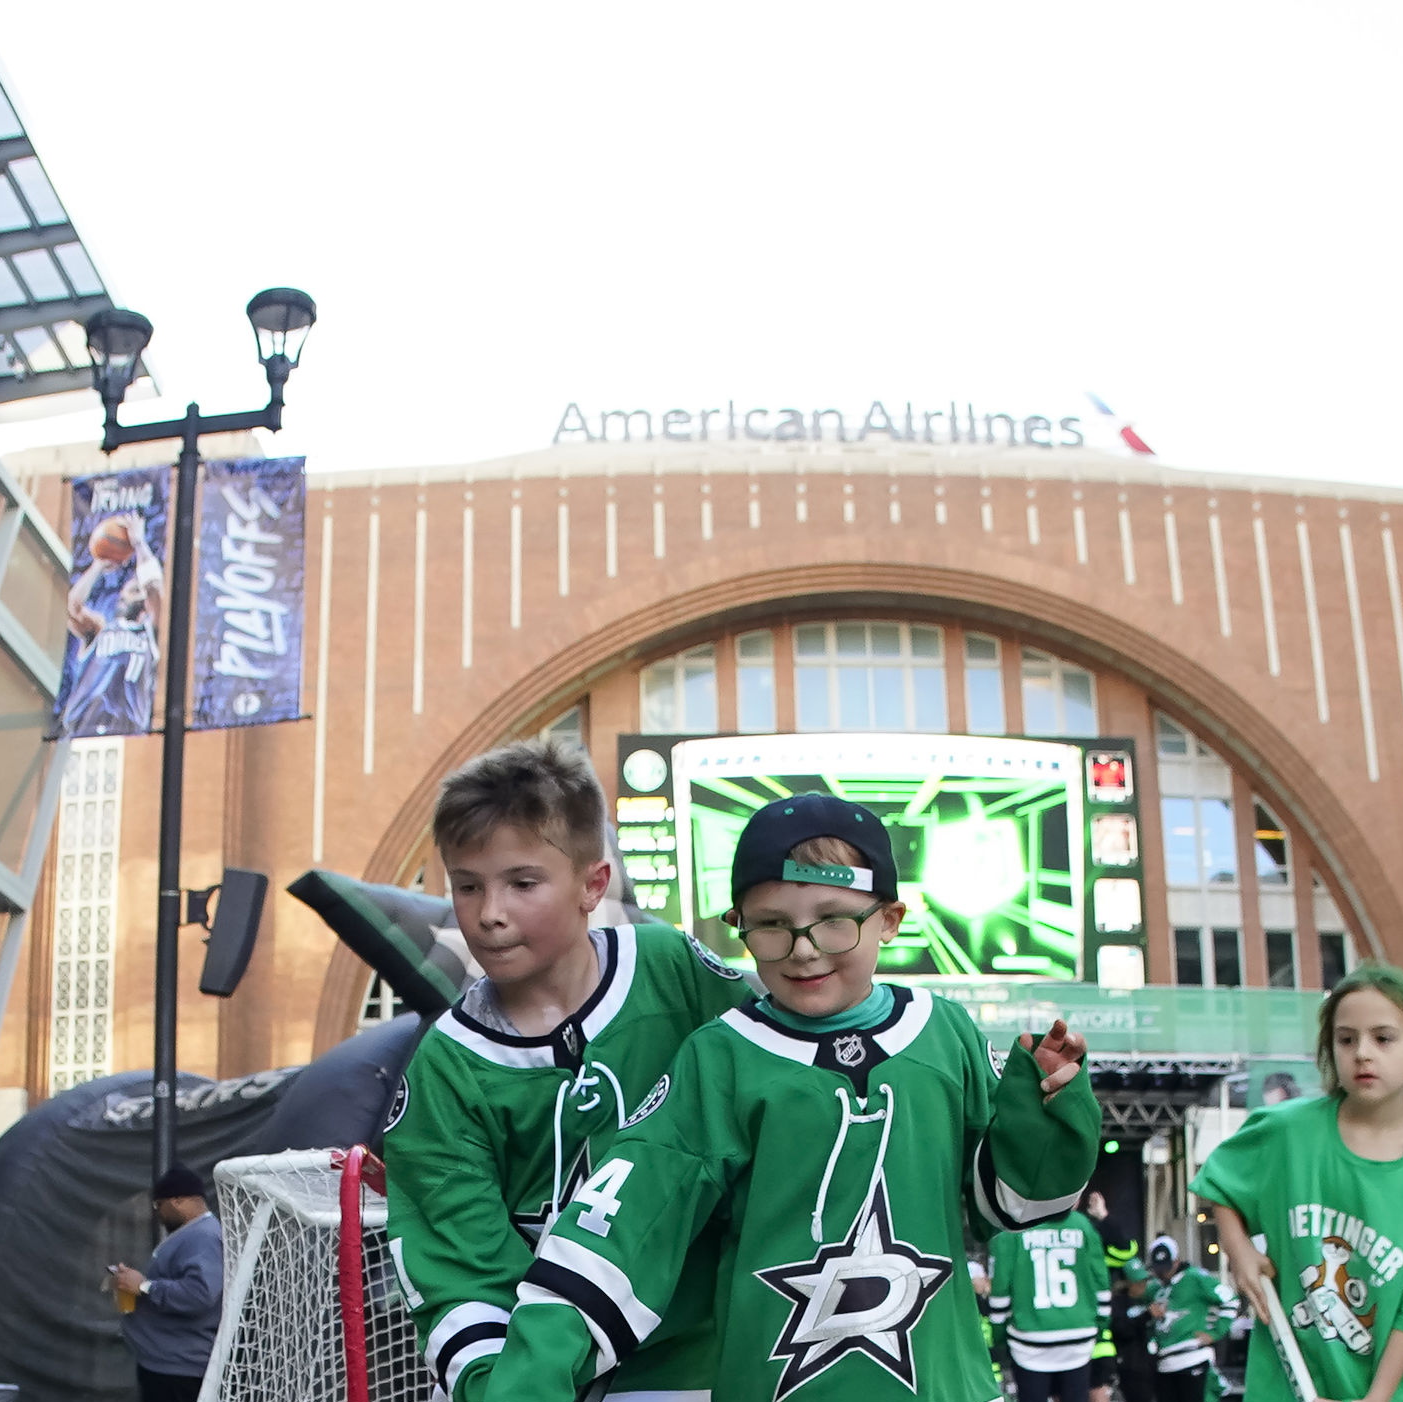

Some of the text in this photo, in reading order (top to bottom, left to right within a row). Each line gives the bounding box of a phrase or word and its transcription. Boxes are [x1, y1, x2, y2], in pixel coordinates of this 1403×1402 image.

[553, 400, 1086, 448] American Airlines
[205, 485, 290, 681] PLAYOFFS
[1029, 1248, 1079, 1310] 16
